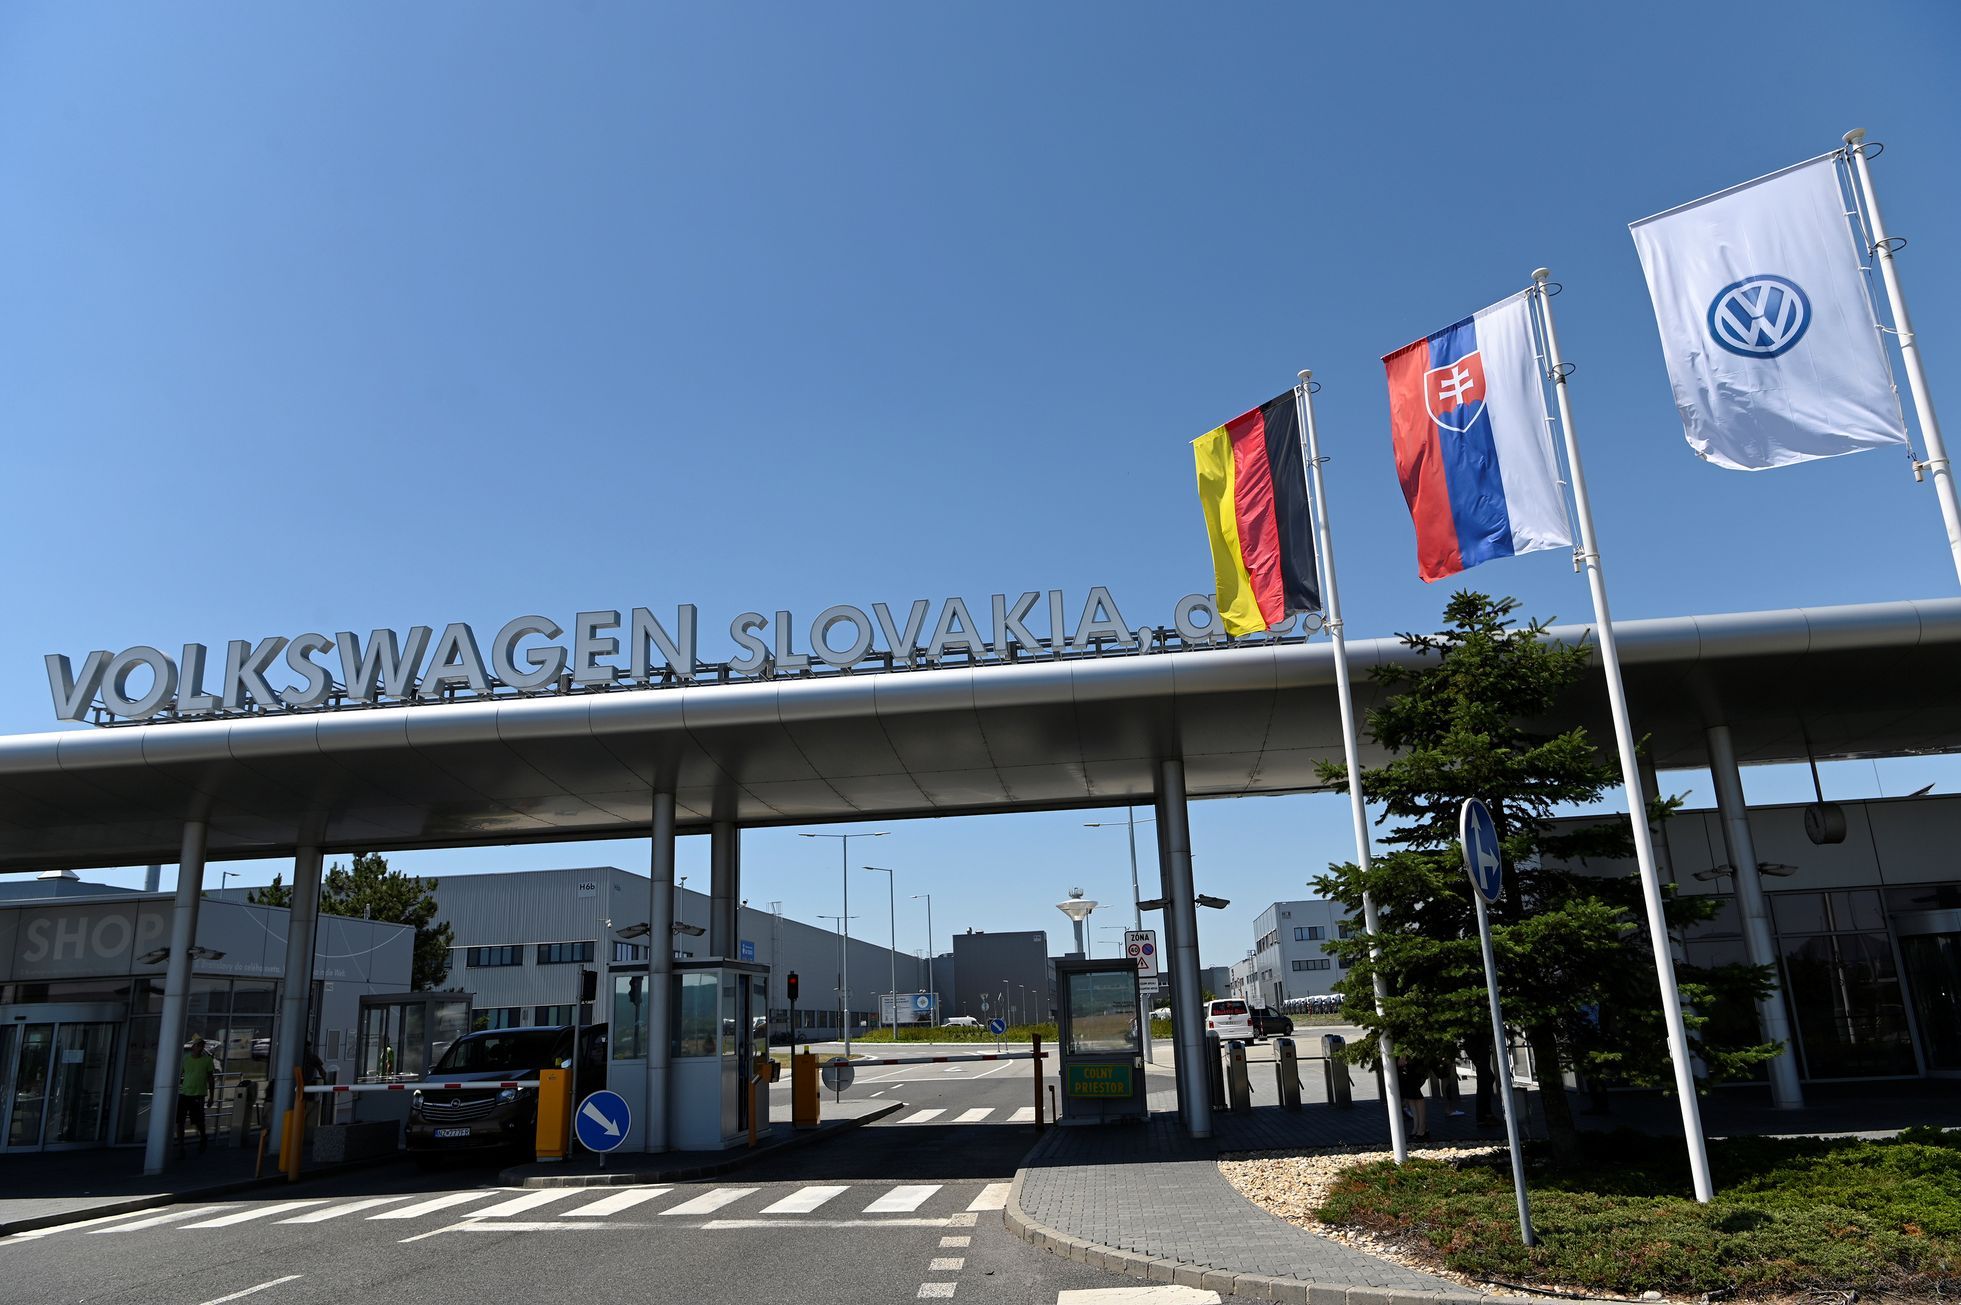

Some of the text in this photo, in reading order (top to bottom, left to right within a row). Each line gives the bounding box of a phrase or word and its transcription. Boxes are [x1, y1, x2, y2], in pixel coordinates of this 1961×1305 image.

[44, 604, 698, 721] VOLKSWAGEN
[728, 586, 1152, 674] SLOVAKIA,
[579, 882, 596, 891] H6b
[22, 913, 165, 962] SHOP
[1130, 933, 1150, 942] ZÓNA
[1075, 1082, 1125, 1093] PRIESTOR
